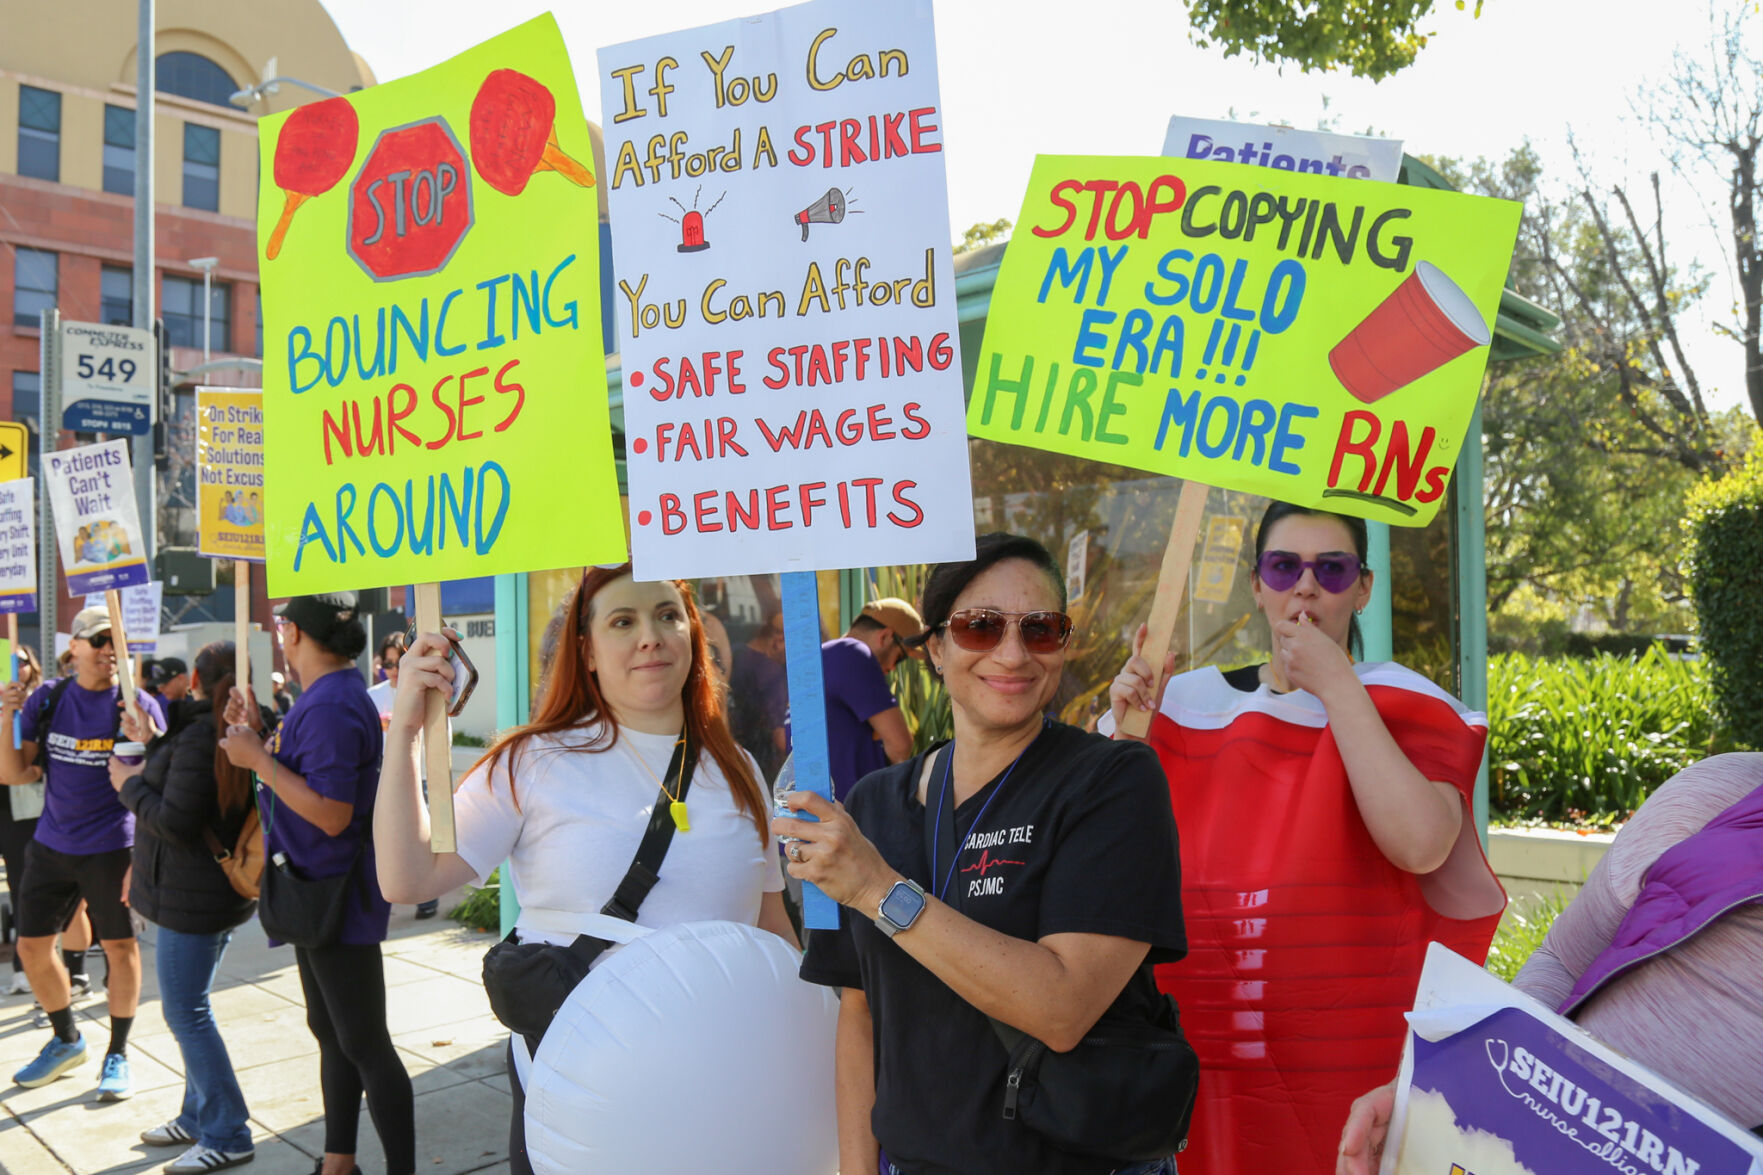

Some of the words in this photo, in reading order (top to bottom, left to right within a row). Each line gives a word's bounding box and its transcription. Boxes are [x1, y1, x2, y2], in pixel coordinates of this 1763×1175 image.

[611, 56, 679, 124] If
[701, 45, 778, 109] You
[806, 28, 909, 91] Can
[612, 127, 742, 190] Afford
[753, 126, 778, 170] A
[788, 106, 942, 168] STRIKE
[363, 162, 458, 246] STOP
[1032, 175, 1186, 242] STOP
[1181, 185, 1413, 273] COPYING
[288, 253, 579, 394] BOUNCING
[619, 273, 687, 338] You
[700, 278, 786, 325] Can
[797, 247, 936, 316] Afford
[1037, 244, 1129, 307] MY
[1144, 249, 1307, 335] SOLO
[77, 353, 137, 383] 549
[90, 337, 144, 352] EXPRESS
[650, 350, 747, 402] SAFE
[762, 332, 954, 390] STAFFING
[209, 405, 225, 422] On
[212, 426, 234, 443] For
[323, 358, 526, 465] NURSES
[656, 416, 749, 463] FAIR
[755, 402, 932, 453] WAGES
[980, 352, 1144, 446] HIRE
[1153, 387, 1320, 476] MORE
[1327, 409, 1450, 503] RNs
[51, 448, 122, 477] Patients
[69, 471, 112, 496] Can't
[200, 466, 223, 484] Not
[226, 467, 264, 487] Excus
[75, 493, 113, 517] Wait
[293, 460, 511, 573] AROUND
[658, 477, 925, 536] BENEFITS
[1008, 825, 1034, 844] TELE
[968, 877, 1004, 898] PSJMC
[1509, 1046, 1701, 1175] SEIU121RN
[1519, 1092, 1578, 1138] nurse
[1587, 1141, 1647, 1175] allia
